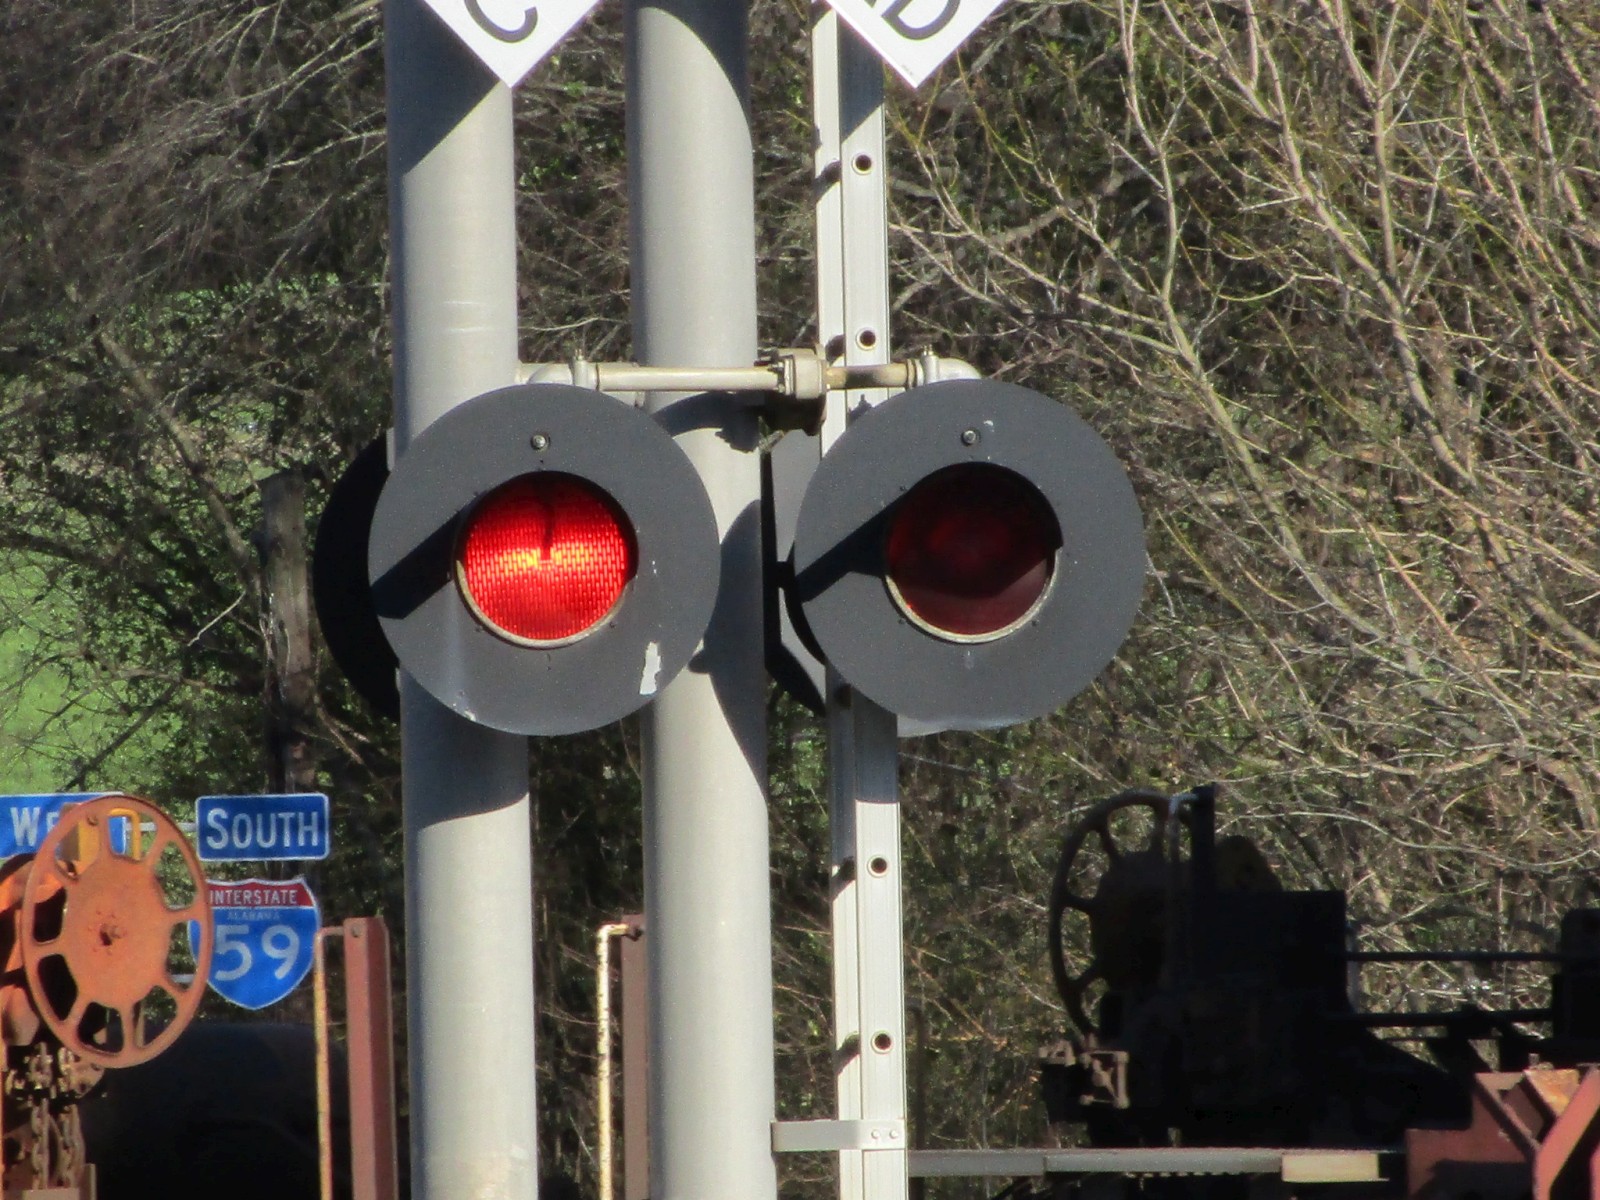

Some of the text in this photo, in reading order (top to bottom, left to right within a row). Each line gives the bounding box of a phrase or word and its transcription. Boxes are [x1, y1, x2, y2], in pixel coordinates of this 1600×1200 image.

[867, 0, 961, 41] D
[206, 807, 319, 850] SOUTH
[209, 889, 298, 905] INTERSTATE
[214, 924, 300, 982] 59
